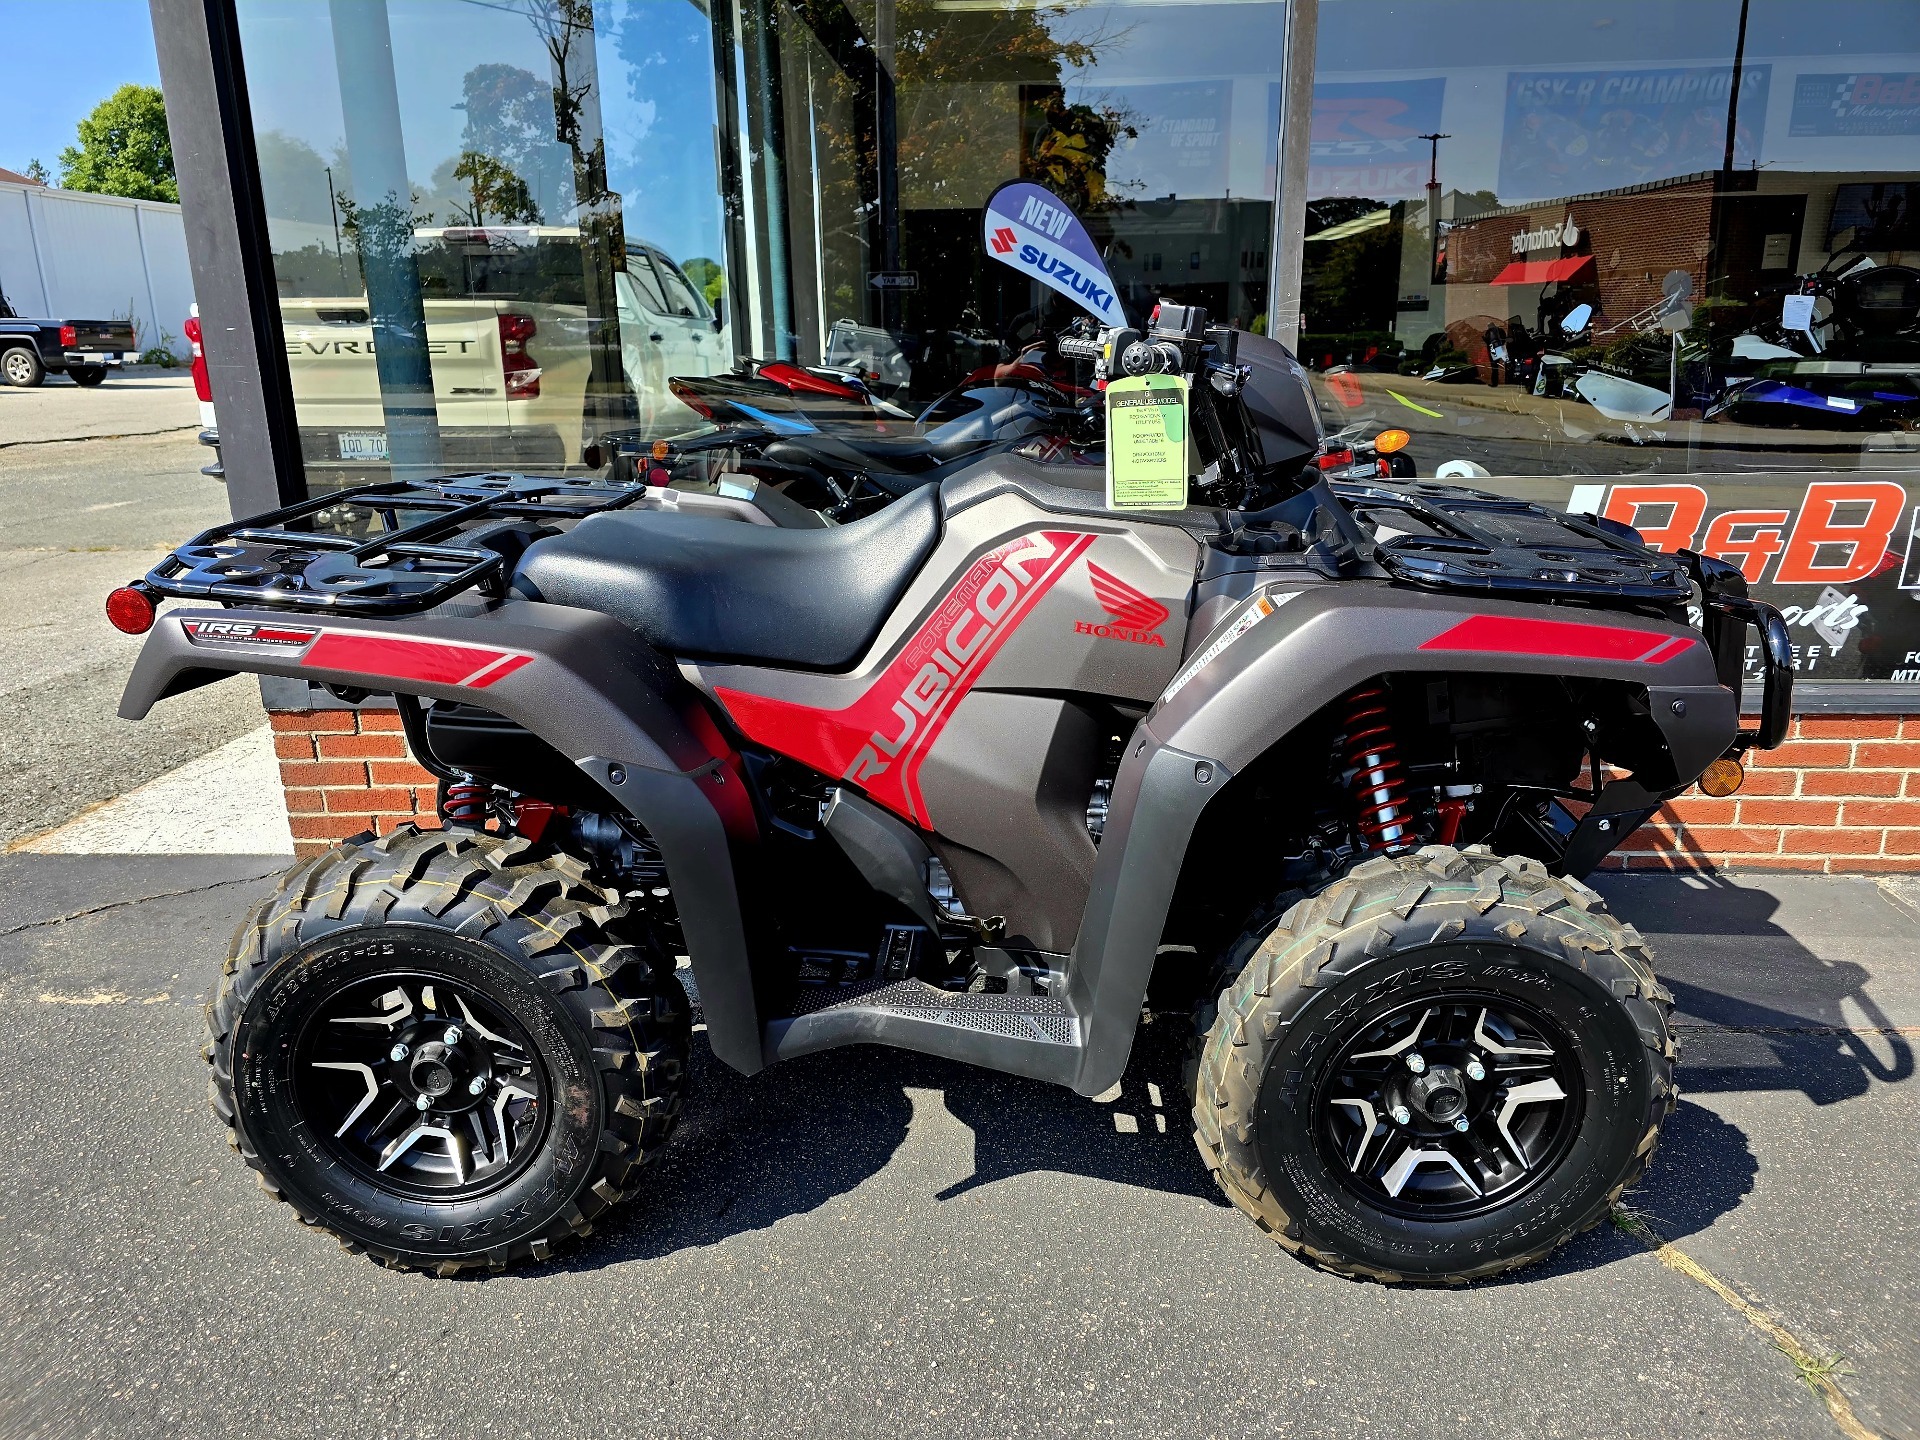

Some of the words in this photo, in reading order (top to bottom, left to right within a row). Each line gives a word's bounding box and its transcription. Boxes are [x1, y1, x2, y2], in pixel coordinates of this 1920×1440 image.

[1184, 132, 1221, 147] SPORT
[1308, 168, 1428, 193] UZUKI
[1019, 195, 1073, 240] NEW
[1019, 244, 1114, 313] SUZUKI
[1116, 399, 1144, 407] GENERAL
[197, 622, 257, 636] IRS
[904, 548, 1004, 670] FOREMAN
[1074, 620, 1167, 647] HONDA
[845, 531, 1056, 782] RUBICON
[1277, 960, 1470, 1115] MAXXIS
[399, 1133, 582, 1244] MAXXIS
